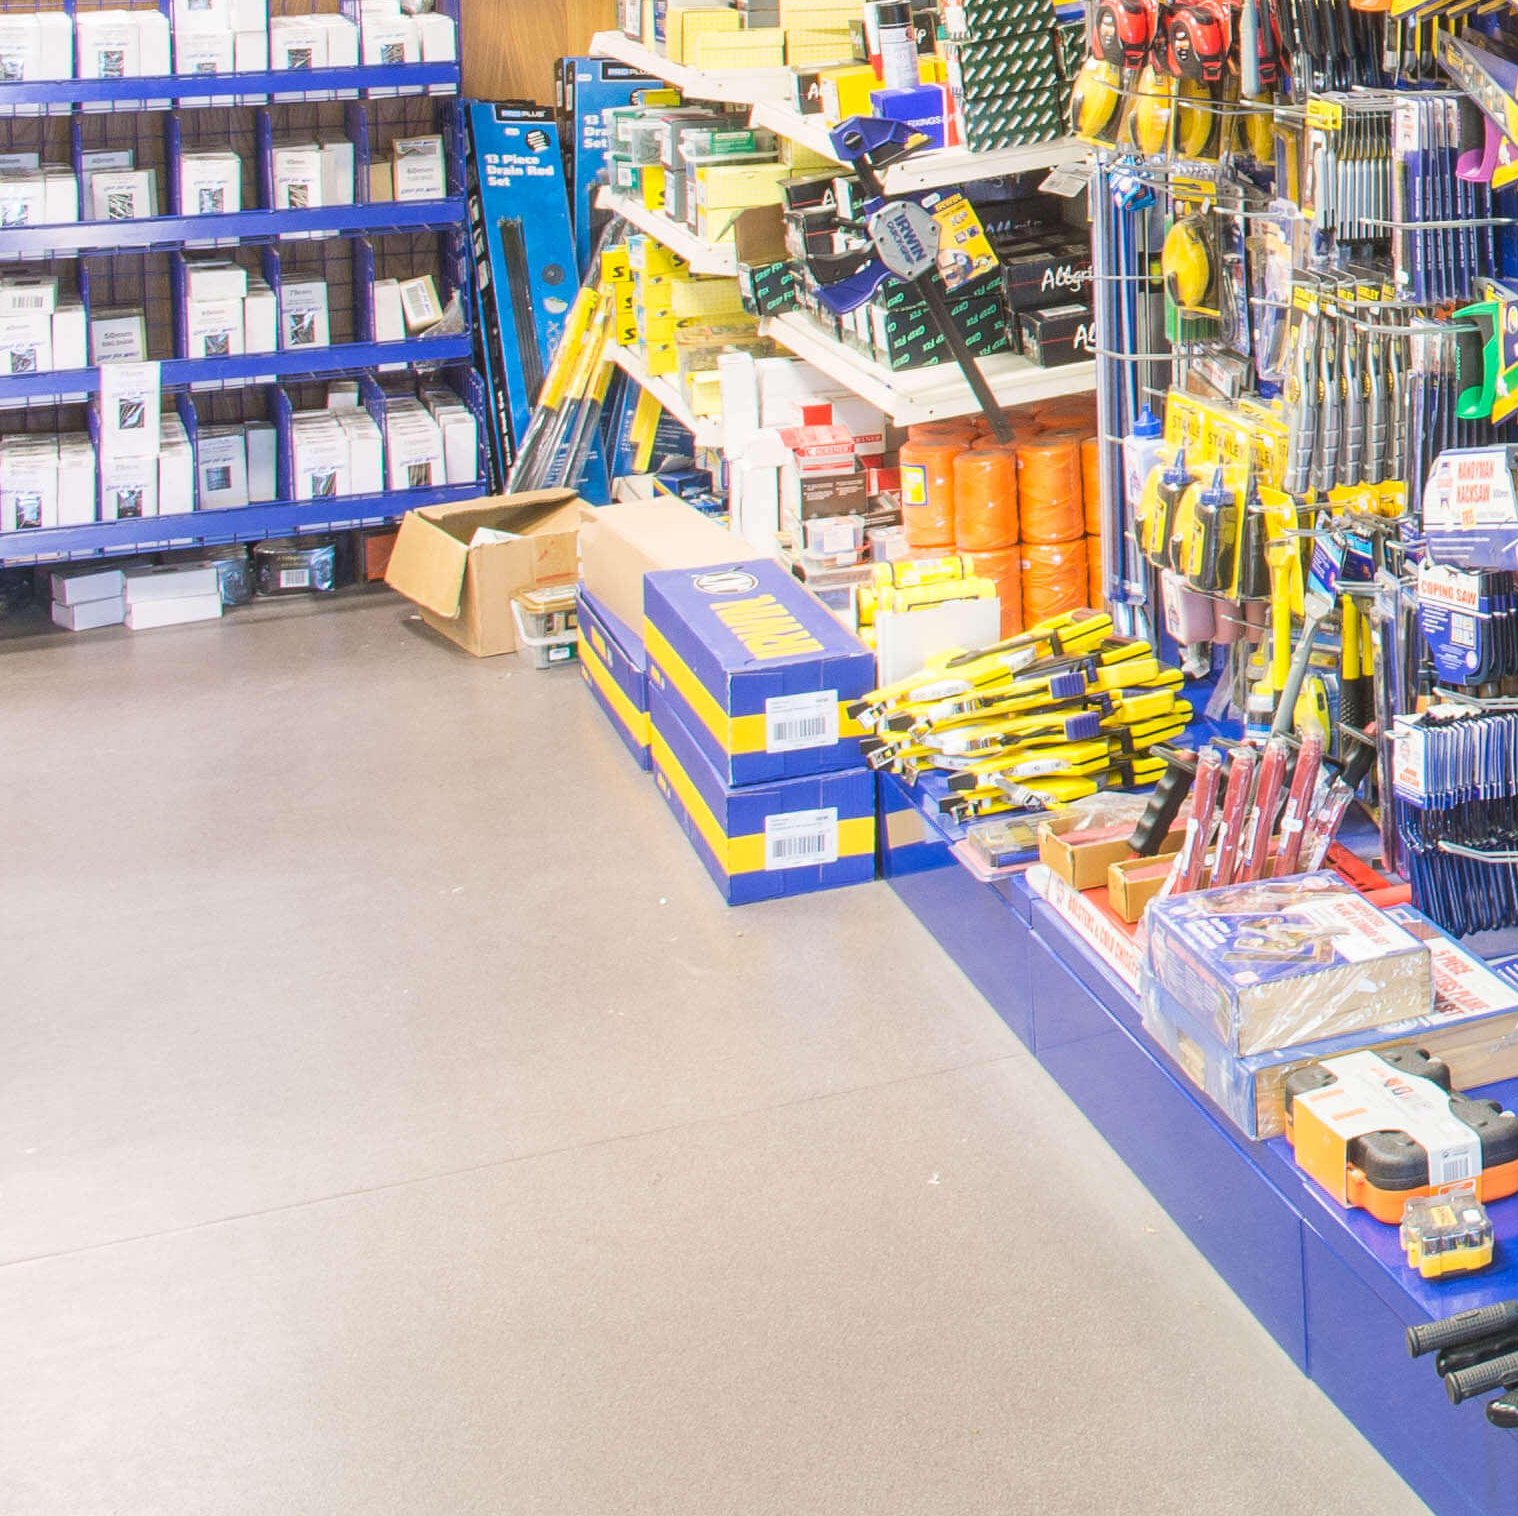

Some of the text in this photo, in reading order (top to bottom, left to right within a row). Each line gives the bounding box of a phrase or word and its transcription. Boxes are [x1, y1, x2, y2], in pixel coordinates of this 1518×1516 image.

[486, 153, 540, 166] 13 Piece
[486, 166, 523, 178] Drain
[486, 176, 511, 188] Set
[894, 214, 927, 265] IRWIN
[1457, 458, 1494, 481] HANDYMAN
[1456, 483, 1490, 505] HACKSAW
[1420, 578, 1478, 606] COPING SAW
[709, 594, 827, 661] IRWIN
